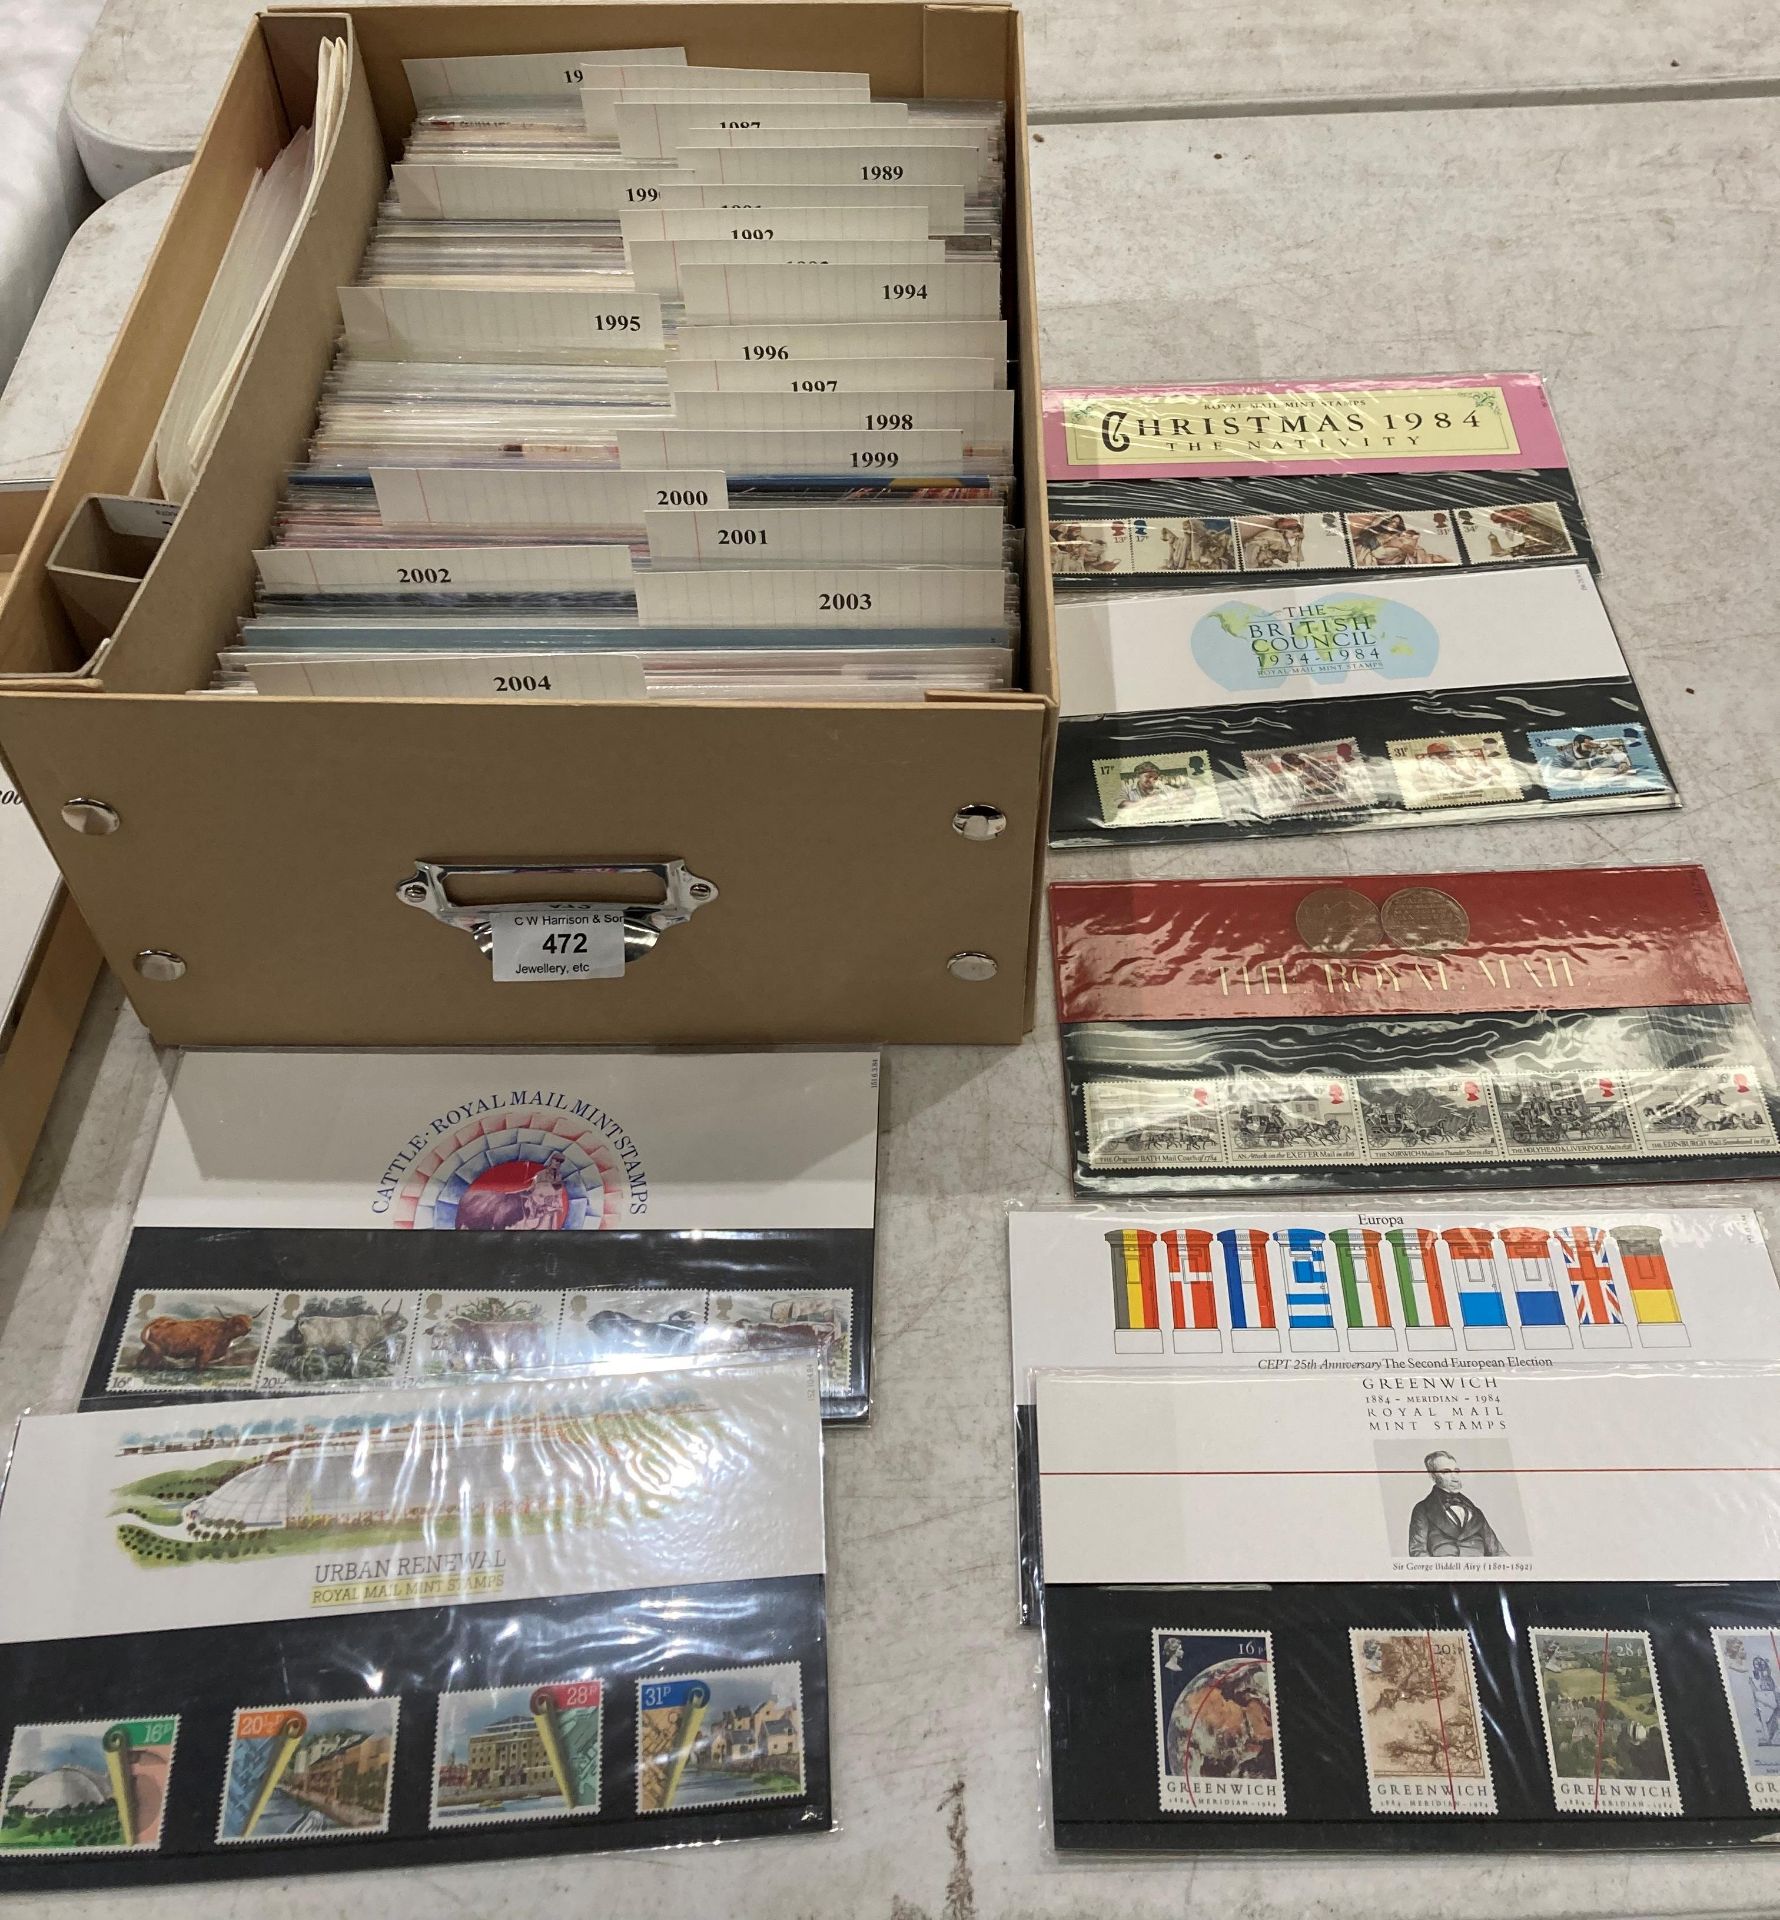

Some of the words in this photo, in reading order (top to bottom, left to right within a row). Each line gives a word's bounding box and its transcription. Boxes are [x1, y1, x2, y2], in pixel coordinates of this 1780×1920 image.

[860, 165, 904, 182] 1989
[625, 187, 660, 203] 199
[882, 284, 928, 301] 1994
[594, 314, 642, 332] 1995
[742, 345, 789, 360] 1996
[865, 414, 913, 430] 1998
[1101, 409, 1364, 452] CHRISTMAS
[1383, 410, 1480, 431] 1984
[1166, 440, 1223, 452] THE
[1248, 436, 1420, 450] NATIVITY
[850, 452, 899, 468] 1999
[656, 489, 708, 507] 2000
[717, 528, 769, 546] 2001
[397, 568, 452, 585] 2002
[818, 593, 873, 612] 2003
[1283, 604, 1327, 618] THE
[1249, 616, 1372, 639] BRITISH
[1251, 631, 1376, 653] COUNCIL
[1257, 668, 1289, 677] ROYAL
[1291, 666, 1316, 674] MAIL
[1318, 664, 1344, 673] MINT
[1346, 661, 1384, 670] STAMPS
[493, 675, 552, 692] 2004
[514, 916, 524, 926] C
[526, 916, 539, 926] W
[542, 915, 589, 926] Harrison
[592, 914, 601, 924] &
[542, 932, 588, 954] 472
[515, 963, 570, 975] Jewellery,
[572, 963, 590, 973] etc
[1523, 1146, 1560, 1154] HOLYHEAD
[1566, 1144, 1605, 1152] LIVERPOOL
[1663, 1140, 1707, 1148] EDINBURGH
[371, 1134, 429, 1214] CATTLE
[429, 1094, 506, 1135] ROYAL
[510, 1090, 568, 1110] MAIL
[570, 1098, 624, 1139] MINT
[614, 1135, 649, 1216] STAMPS
[1286, 1151, 1320, 1159] EXETER
[1387, 1150, 1420, 1158] NORWICH
[1358, 1213, 1405, 1228] Europa
[1257, 1358, 1290, 1370] CEPT
[1293, 1359, 1317, 1370] 25th
[1319, 1358, 1382, 1372] Anniversary
[1382, 1357, 1406, 1370] The
[1407, 1356, 1449, 1369] Second
[1450, 1356, 1506, 1371] European
[1508, 1355, 1553, 1368] Election
[1362, 1376, 1499, 1390] GREENWICH
[1365, 1395, 1390, 1405] 1884
[1407, 1395, 1459, 1403] MERIDIAN
[1474, 1395, 1501, 1404] 1984
[1368, 1406, 1437, 1417] ROYAL
[1452, 1406, 1503, 1417] MAIL
[1369, 1420, 1418, 1431] MINT
[1434, 1420, 1507, 1431] STAMPS
[315, 1559, 390, 1584] URBAN
[398, 1550, 507, 1576] RENEWAL
[1392, 1562, 1404, 1571] Sir
[1406, 1562, 1433, 1572] George
[1435, 1562, 1461, 1571] Biddell
[1463, 1562, 1480, 1572] Airy
[312, 1587, 359, 1604] ROYAL
[364, 1583, 400, 1599] MAIL
[405, 1579, 443, 1595] MINT
[447, 1573, 504, 1592] STAMPS
[1167, 1781, 1277, 1797] GREENWICH
[1377, 1783, 1488, 1798] GREENWICH
[1560, 1782, 1672, 1798] GREENWICH
